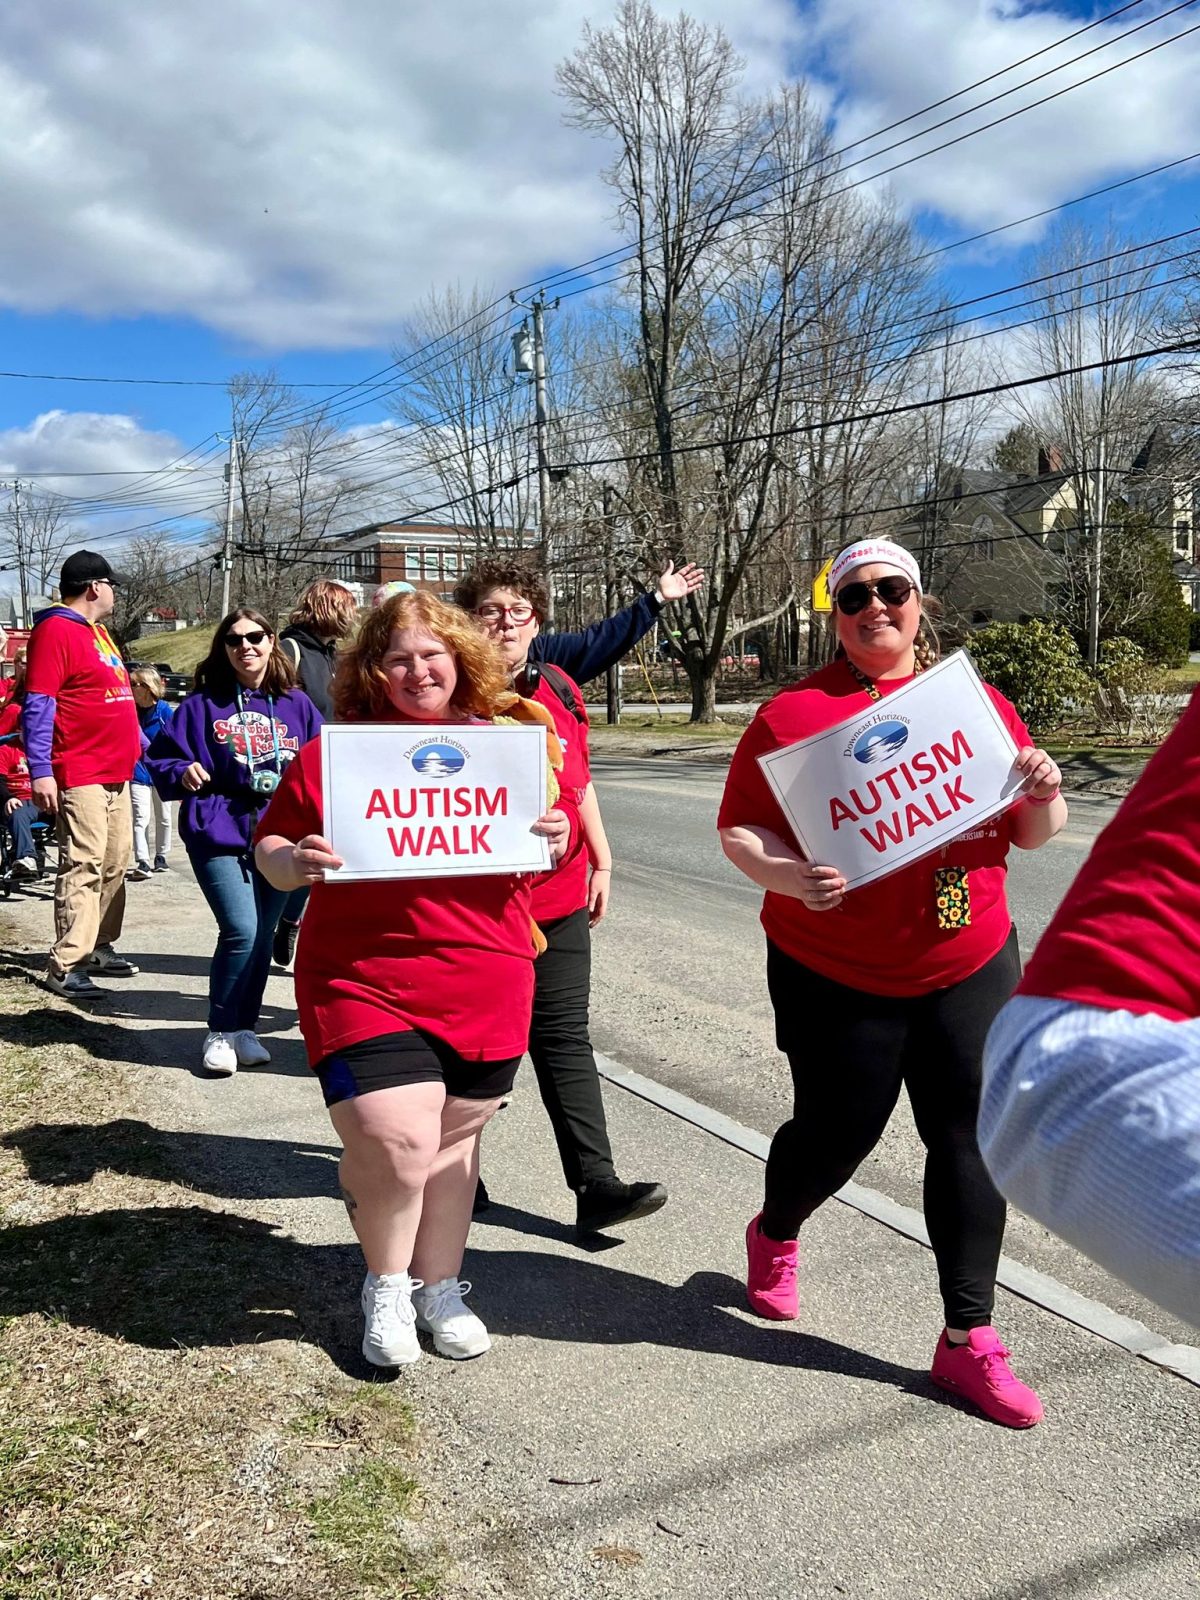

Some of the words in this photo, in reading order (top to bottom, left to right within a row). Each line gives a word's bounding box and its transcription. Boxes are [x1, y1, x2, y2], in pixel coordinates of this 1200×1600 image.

[214, 720, 288, 744] Strawbery
[249, 735, 299, 756] Fesival
[403, 736, 439, 759] Downeast
[440, 735, 471, 759] Horizons
[843, 720, 873, 757] Downeast
[872, 711, 912, 725] Horizons
[831, 731, 973, 828] AUTISM
[366, 787, 507, 819] AUTISM
[861, 776, 974, 852] WALK
[388, 825, 491, 857] WALK
